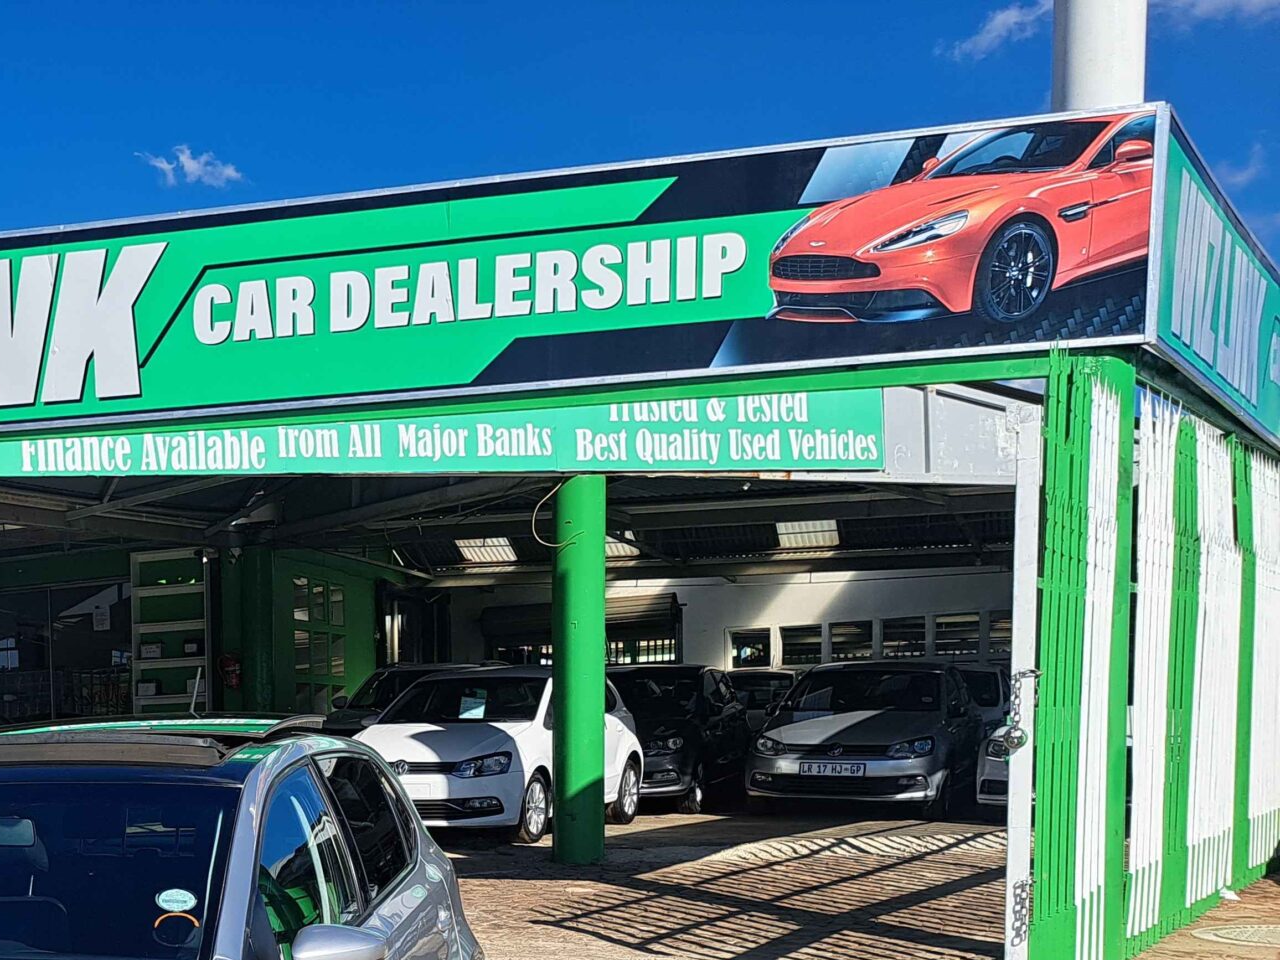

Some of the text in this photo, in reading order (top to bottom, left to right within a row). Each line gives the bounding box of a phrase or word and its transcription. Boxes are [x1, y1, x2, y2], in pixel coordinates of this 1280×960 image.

[192, 231, 747, 345] CAR DEALERSHIP
[1171, 166, 1268, 407] WIZ LINK
[22, 422, 553, 472] Finance Available from All Major Banks
[575, 427, 879, 465] Best Quality Used Vehicles
